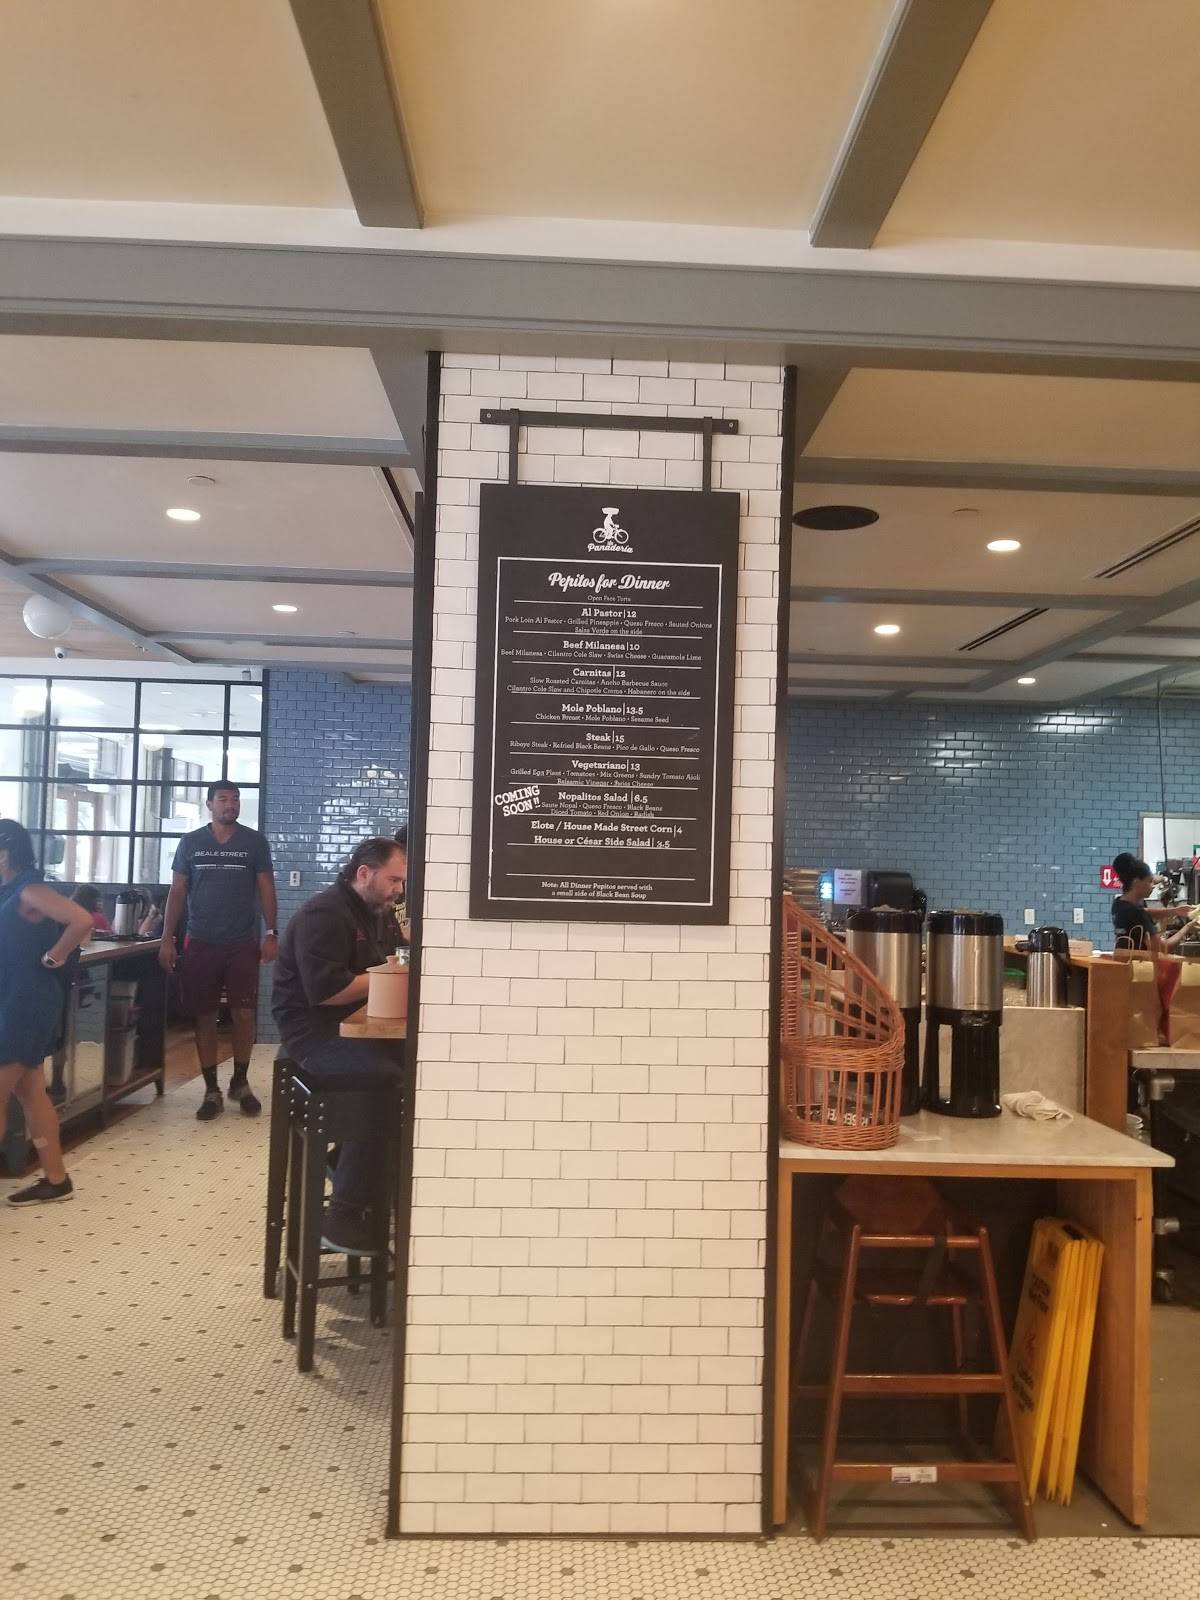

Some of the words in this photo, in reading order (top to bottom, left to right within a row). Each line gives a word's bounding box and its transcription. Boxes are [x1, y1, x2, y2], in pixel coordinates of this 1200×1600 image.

[548, 572, 595, 592] Pepitos
[595, 574, 617, 593] for
[618, 574, 670, 590] Dinner
[581, 608, 592, 617] Al
[590, 619, 620, 627] Pineapple
[563, 640, 583, 649] Beef
[576, 687, 602, 695] Chipotle
[562, 704, 584, 712] Mole
[494, 785, 540, 805] COMING
[558, 792, 602, 802] Nopalitos
[603, 792, 628, 802] Salad
[531, 820, 554, 830] Elote
[564, 822, 592, 831] House
[594, 822, 618, 832] Made
[620, 823, 648, 832] Street
[534, 836, 562, 845] House
[604, 836, 624, 846] Side
[593, 882, 616, 890] Pepitos
